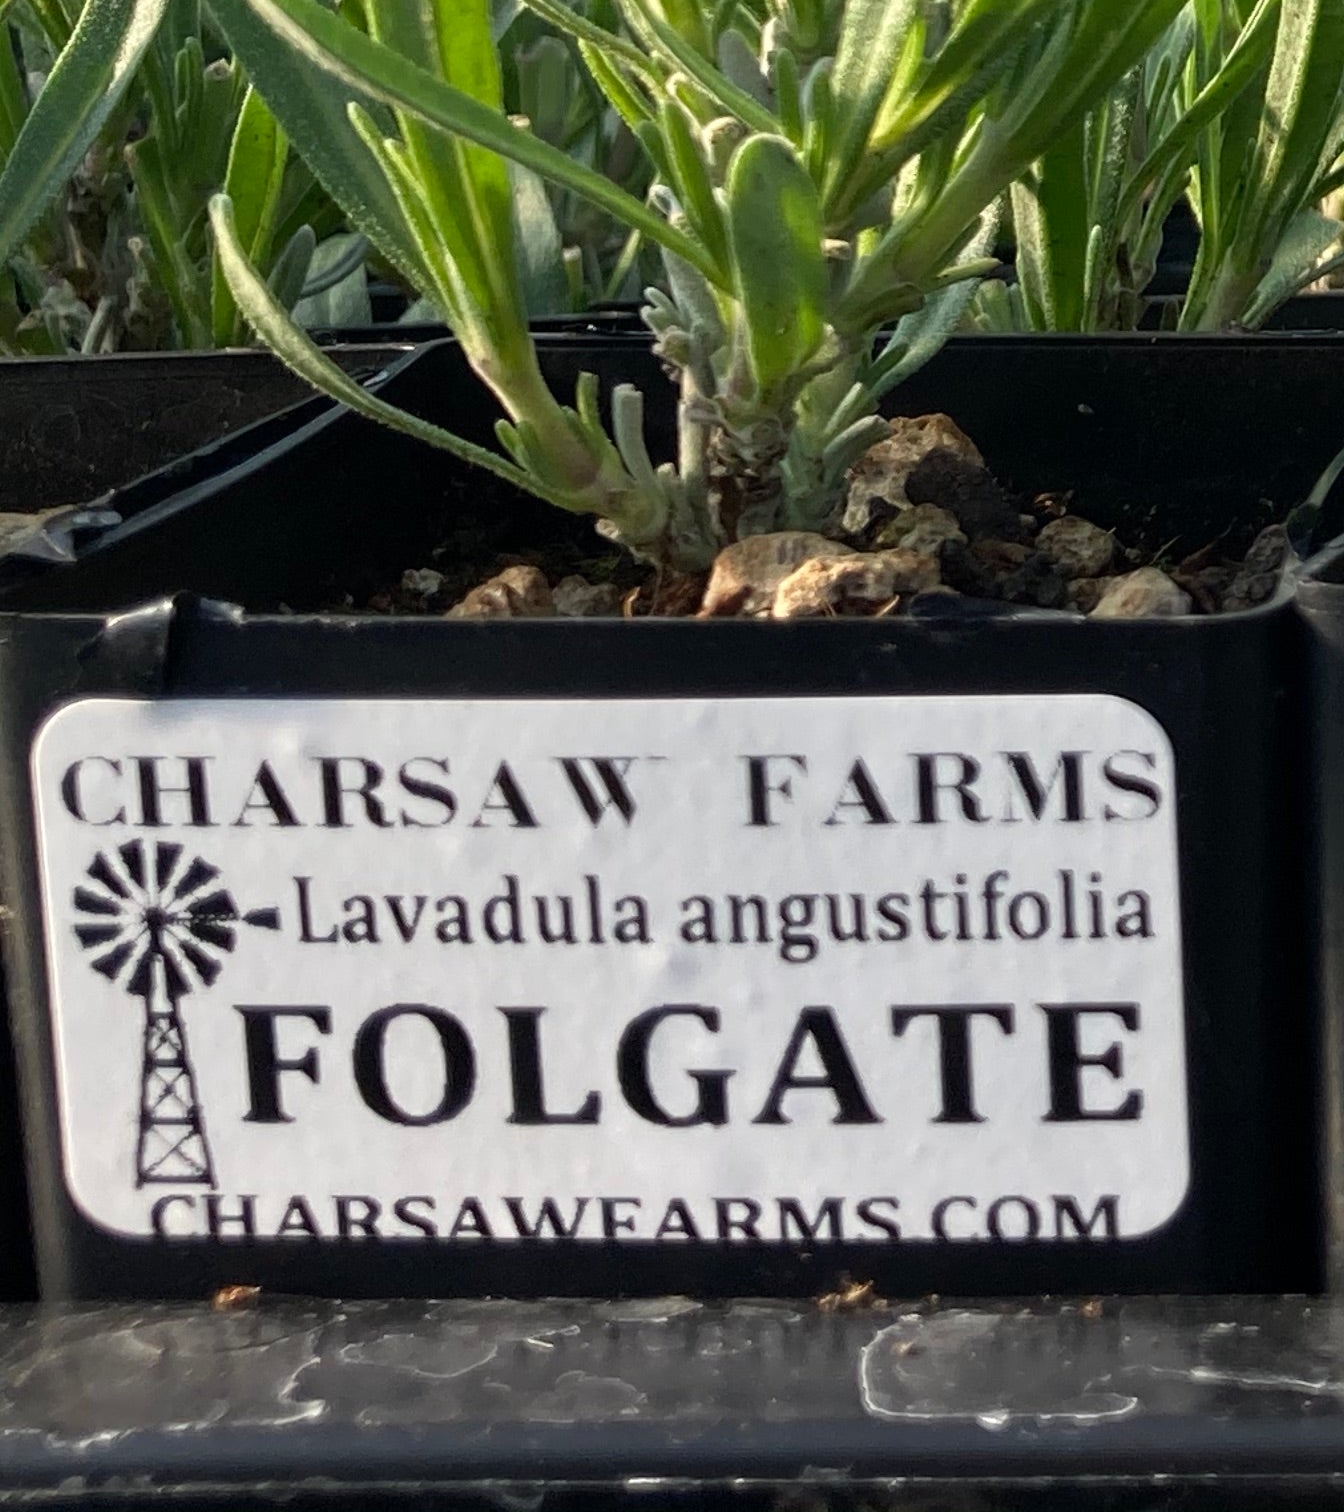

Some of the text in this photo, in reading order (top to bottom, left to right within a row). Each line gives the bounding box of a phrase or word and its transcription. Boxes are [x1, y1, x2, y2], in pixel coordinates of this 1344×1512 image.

[59, 750, 1164, 830] CHARSAW FARMS
[294, 872, 1155, 961] Lavadula angustifolia
[234, 1003, 1143, 1127] FOLGATE
[151, 1194, 1121, 1240] CHARSAWFARMSCOM
